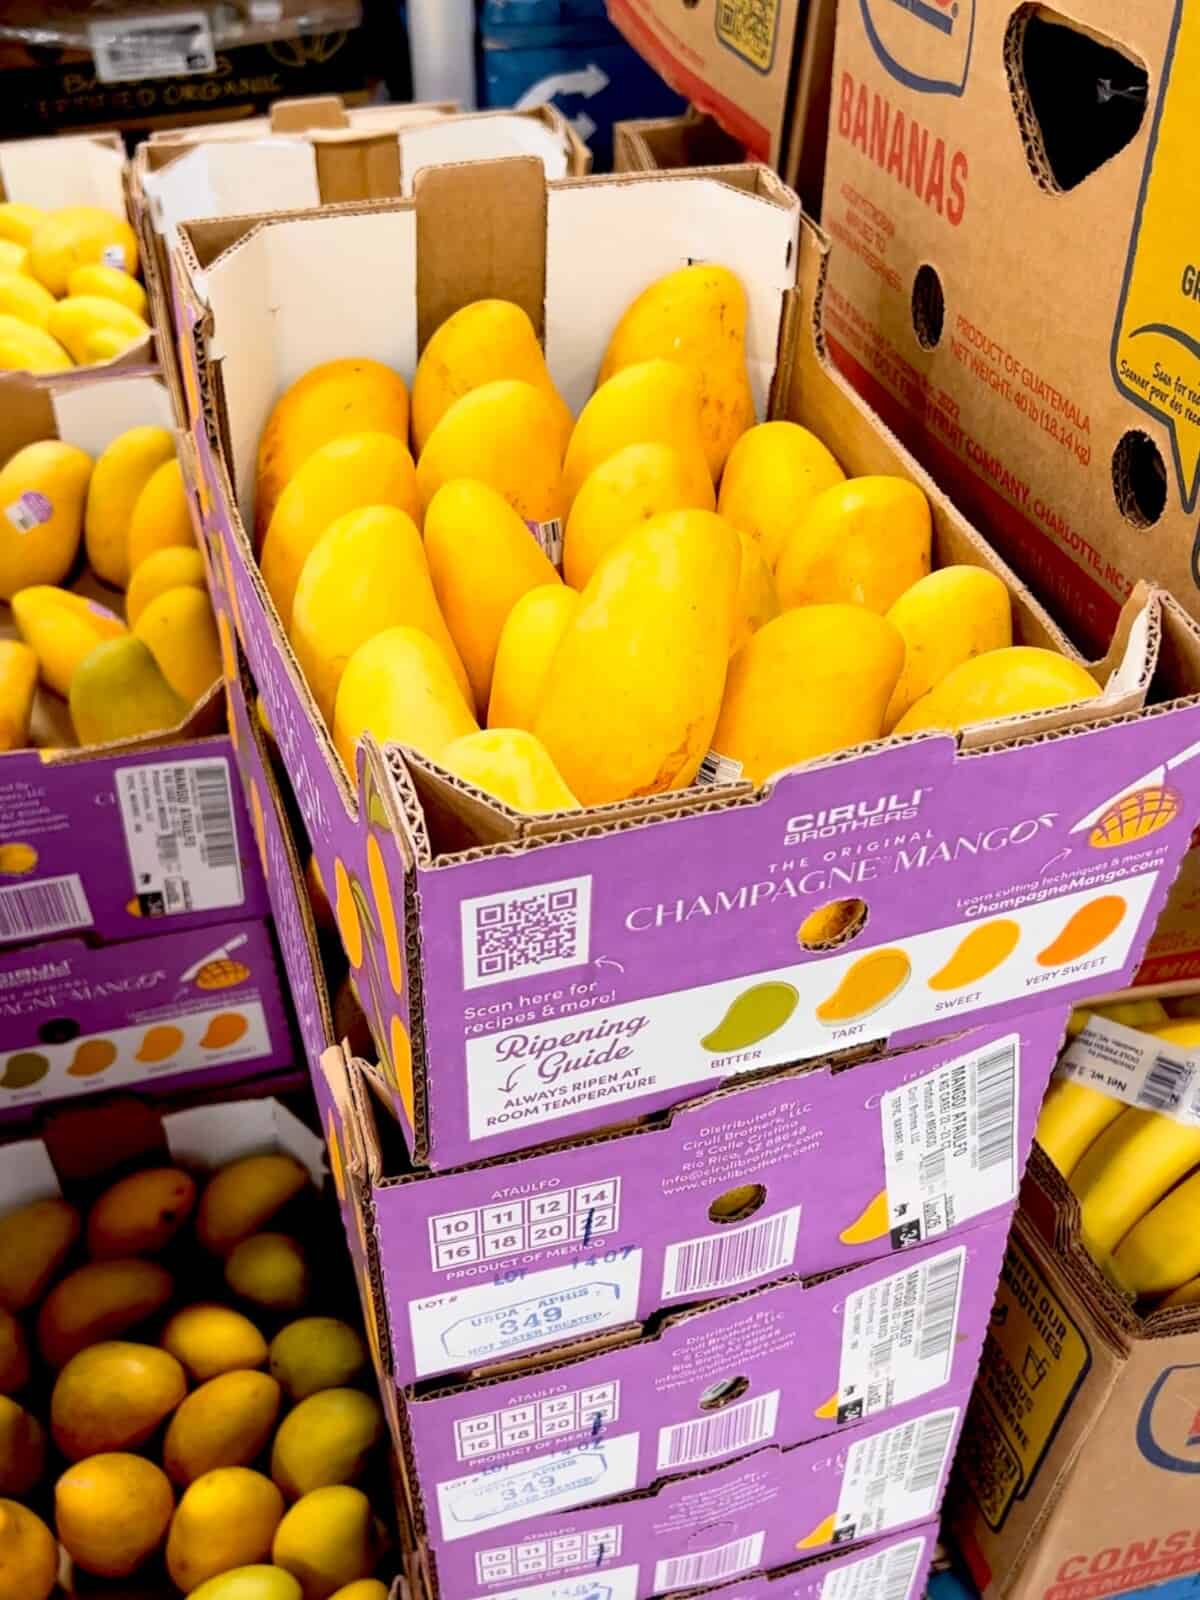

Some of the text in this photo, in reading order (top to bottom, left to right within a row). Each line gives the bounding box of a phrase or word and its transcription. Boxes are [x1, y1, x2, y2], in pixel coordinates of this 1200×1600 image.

[836, 71, 969, 227] BANANAS
[956, 314, 1004, 365] PRODUCT
[1003, 355, 1022, 378] OF
[1021, 367, 1091, 435] GUATEMALA
[1013, 391, 1029, 414] 40
[782, 807, 920, 847] BROTHERS
[785, 788, 923, 834] CIRULI
[767, 829, 936, 875] THE ORIGINAL
[624, 816, 1044, 932] CHAMPAGNE MANGO
[956, 844, 1169, 909] Learn cutting techniques & more at
[964, 856, 1165, 919] ChampagneMango.com
[1025, 955, 1109, 989] VERY SWEET
[463, 981, 599, 1021] Scan here for
[464, 989, 617, 1036] recipes & more!
[934, 991, 984, 1013] SWEET
[495, 1015, 651, 1064] Ripening
[830, 1023, 868, 1041] TART
[536, 1037, 635, 1085] Guide
[709, 1049, 763, 1070] BITTER
[486, 1074, 657, 1128] ROOM TEMPERATURE
[503, 1066, 642, 1110] ALWAYS RIPEN AT
[1107, 1075, 1128, 1093] Net
[699, 1107, 778, 1139] Distributed
[788, 1103, 813, 1119] LLC
[951, 1110, 968, 1159] ATAULFO
[681, 1159, 705, 1172] Rio
[489, 1177, 562, 1201] ATAULFO
[442, 1189, 609, 1237] 10 11 12 14
[442, 1245, 471, 1261] 16
[490, 1234, 517, 1250] 18
[534, 1225, 563, 1241] 20
[446, 1238, 607, 1281] PRODUCT OF MEXICO
[417, 1297, 444, 1311] LOT
[470, 1306, 520, 1328] USDA
[499, 1305, 564, 1337] 349
[1039, 1297, 1067, 1341] OUR
[464, 1391, 610, 1434] 10 11 12 14
[507, 1383, 569, 1406] ATAULFO
[545, 1419, 570, 1433] 20
[468, 1446, 534, 1467] PRODUCT
